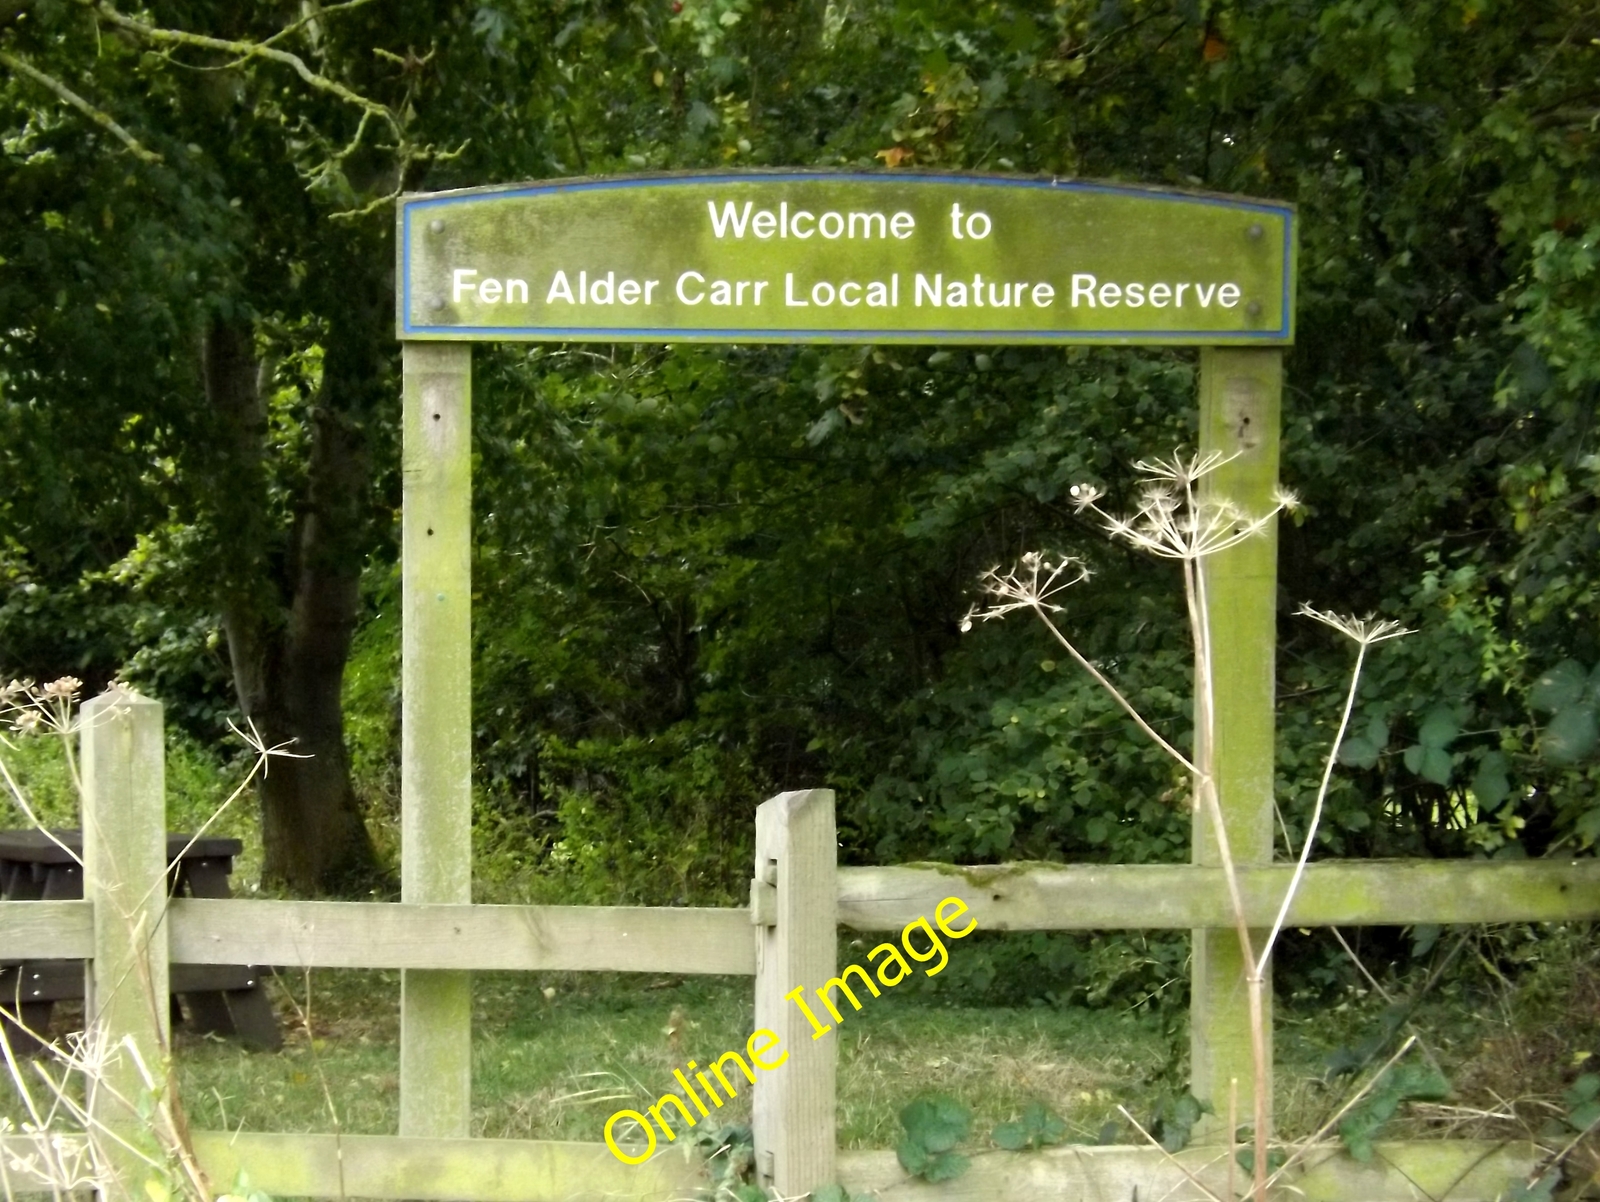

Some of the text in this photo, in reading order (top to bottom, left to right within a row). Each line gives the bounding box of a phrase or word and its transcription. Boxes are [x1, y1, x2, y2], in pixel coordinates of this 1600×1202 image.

[707, 200, 992, 240] Welcome to
[451, 267, 1242, 309] Fen Alder Carr Local Nature Reserve
